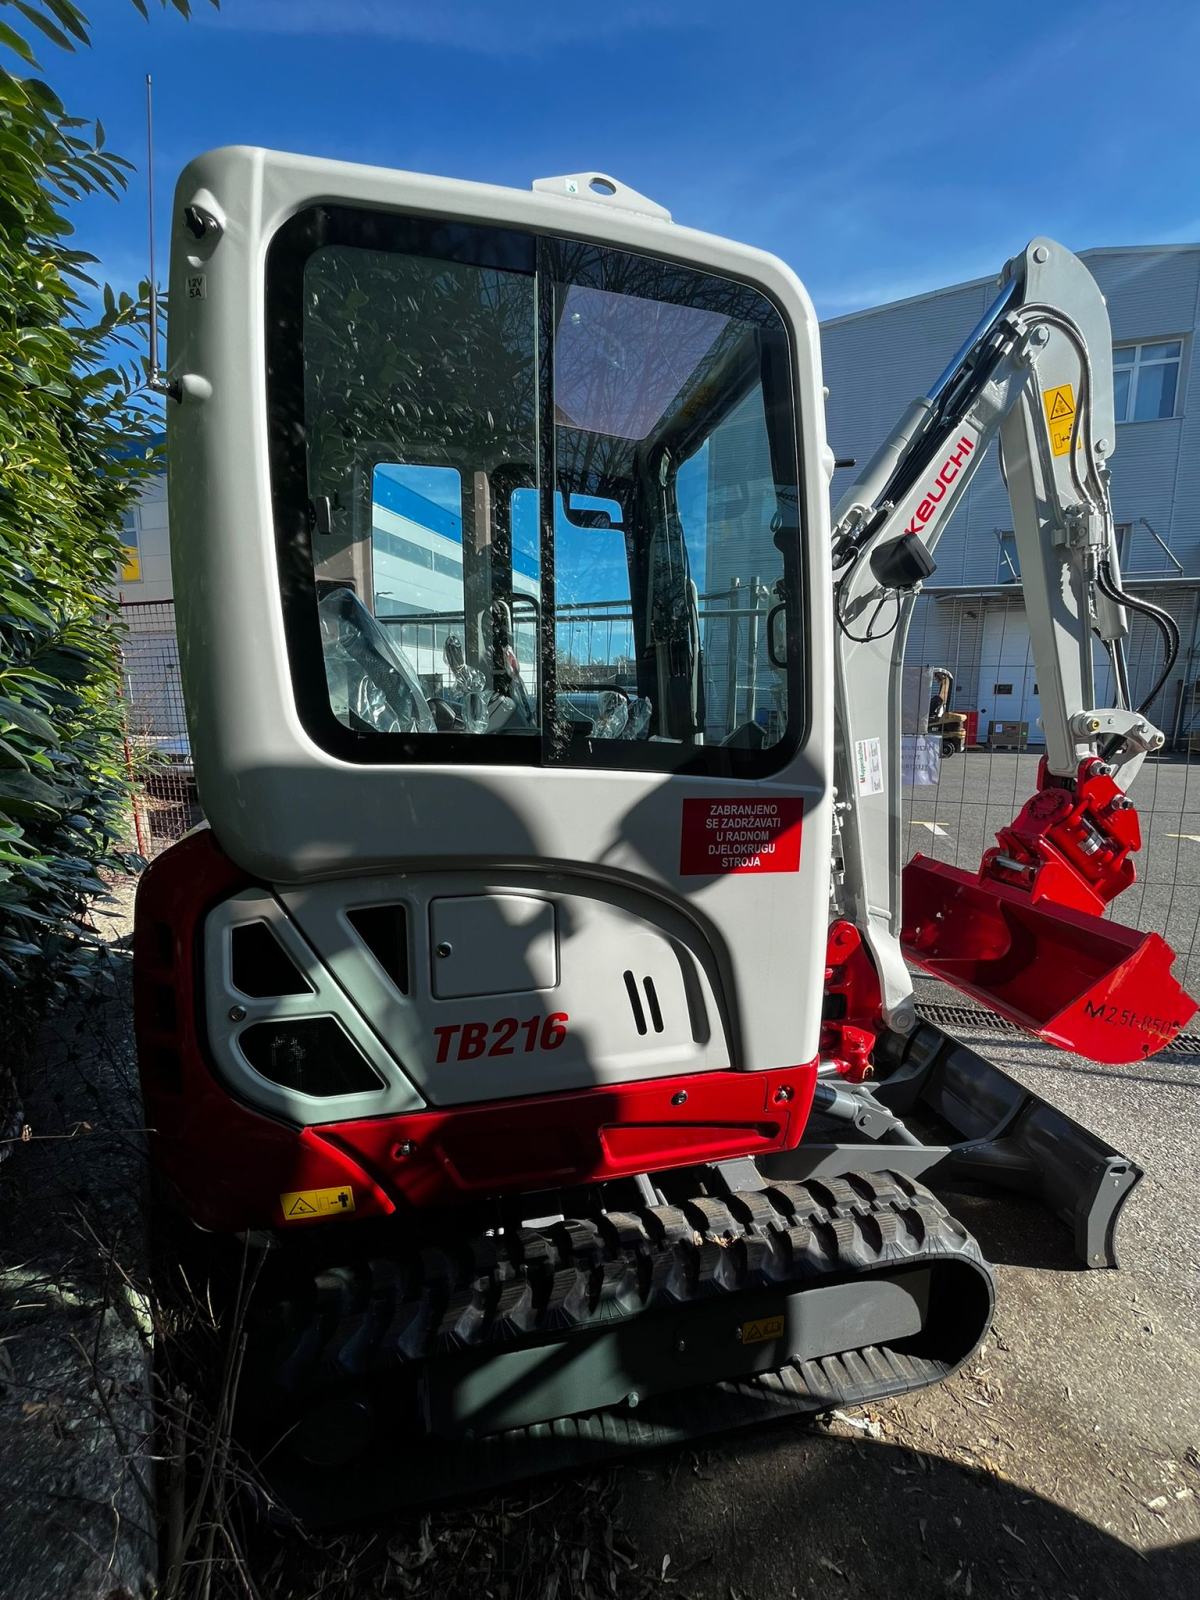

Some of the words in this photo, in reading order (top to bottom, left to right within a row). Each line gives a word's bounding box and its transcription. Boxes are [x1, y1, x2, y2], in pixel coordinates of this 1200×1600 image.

[188, 277, 202, 287] 12V
[189, 287, 201, 298] 5A
[710, 805, 777, 815] ZABRANJENO
[706, 818, 719, 829] SE
[721, 816, 781, 828] ZADRŽAVATI
[717, 832, 723, 841] U
[726, 831, 769, 841] RADNOM
[708, 844, 775, 855] DJELOKRUGU
[721, 857, 760, 867] STROJA
[433, 1012, 569, 1063] TB216
